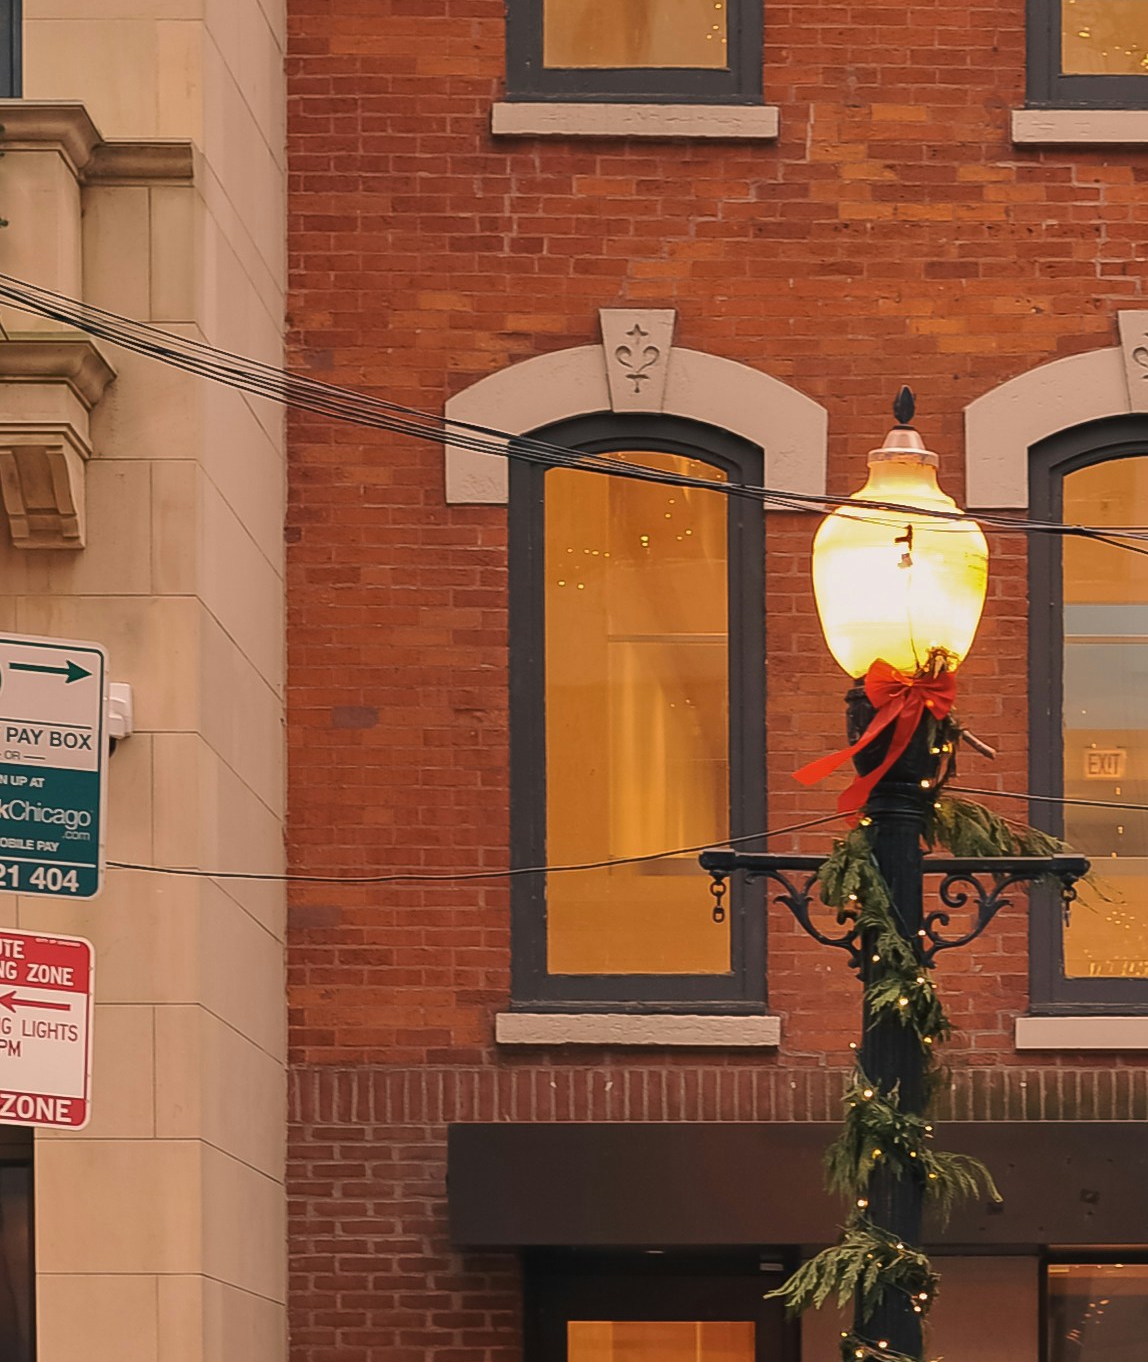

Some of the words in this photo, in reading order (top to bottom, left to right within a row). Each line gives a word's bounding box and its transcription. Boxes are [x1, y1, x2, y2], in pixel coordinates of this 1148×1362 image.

[6, 726, 43, 745] PAY
[50, 730, 92, 750] BOX
[4, 750, 21, 761] OR
[1088, 753, 1121, 775] EXIT
[10, 776, 28, 787] UP
[29, 777, 45, 788] AT
[36, 841, 60, 852] PAY
[29, 866, 79, 892] 404
[0, 938, 25, 959] TE
[26, 963, 74, 986] ZONE
[22, 1019, 78, 1042] LIGHTS
[0, 1093, 72, 1123] ZONE
